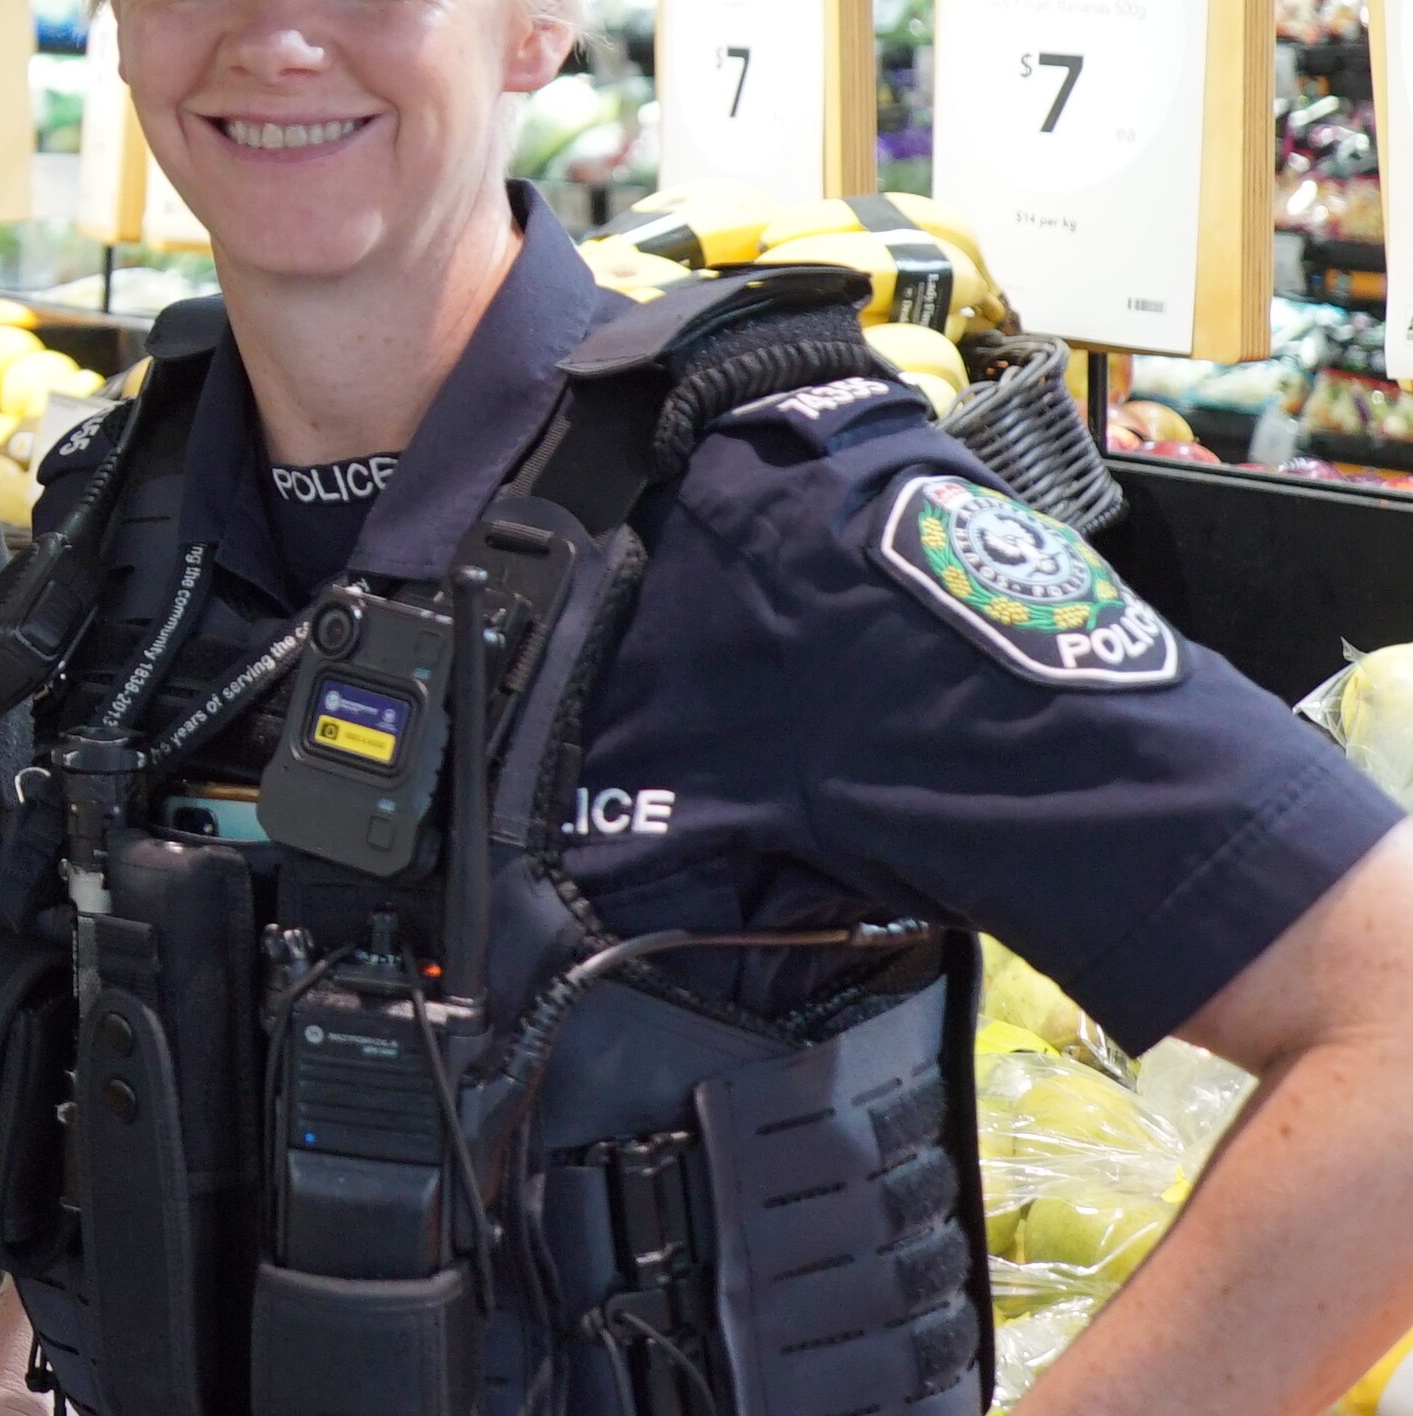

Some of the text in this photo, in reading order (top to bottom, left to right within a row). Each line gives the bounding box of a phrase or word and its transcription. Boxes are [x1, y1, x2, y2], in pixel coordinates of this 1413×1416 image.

[1019, 52, 1084, 133] $7
[1039, 216, 1059, 229] per
[1062, 215, 1078, 232] kg
[776, 377, 890, 421] 74355
[181, 565, 203, 589] the
[144, 589, 193, 662] community
[170, 710, 208, 749] years
[206, 693, 224, 714] of
[223, 655, 277, 700] serving
[270, 633, 297, 659] the
[560, 786, 677, 835] ICE
